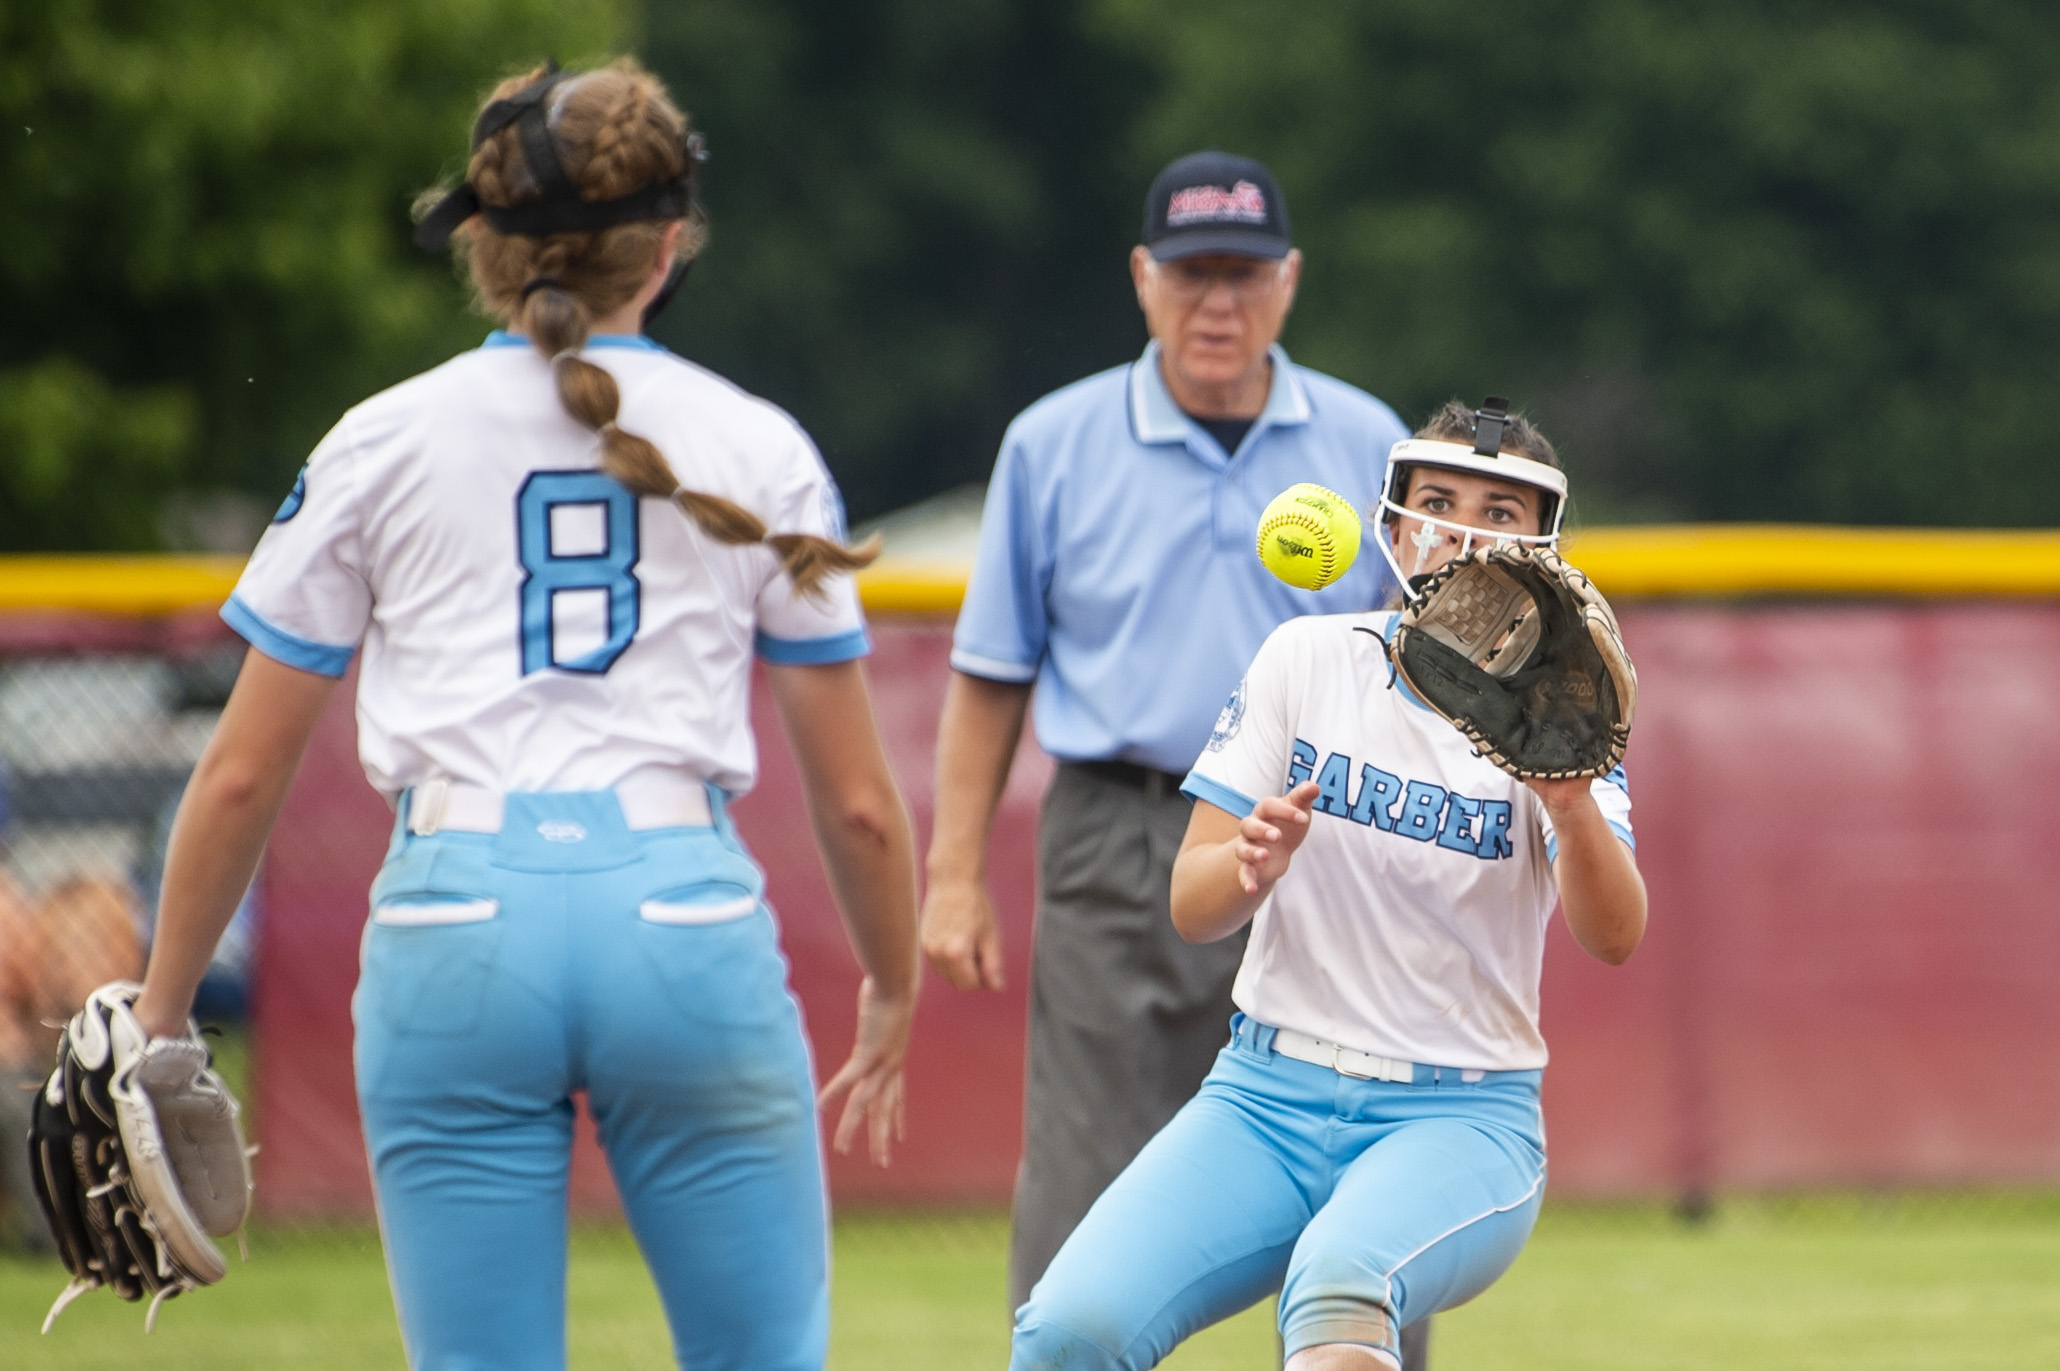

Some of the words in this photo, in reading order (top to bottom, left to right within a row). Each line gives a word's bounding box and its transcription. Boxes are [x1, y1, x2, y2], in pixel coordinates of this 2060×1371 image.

[515, 469, 641, 678] 8
[1276, 535, 1314, 559] Wilson
[1285, 738, 1514, 861] GARBER
